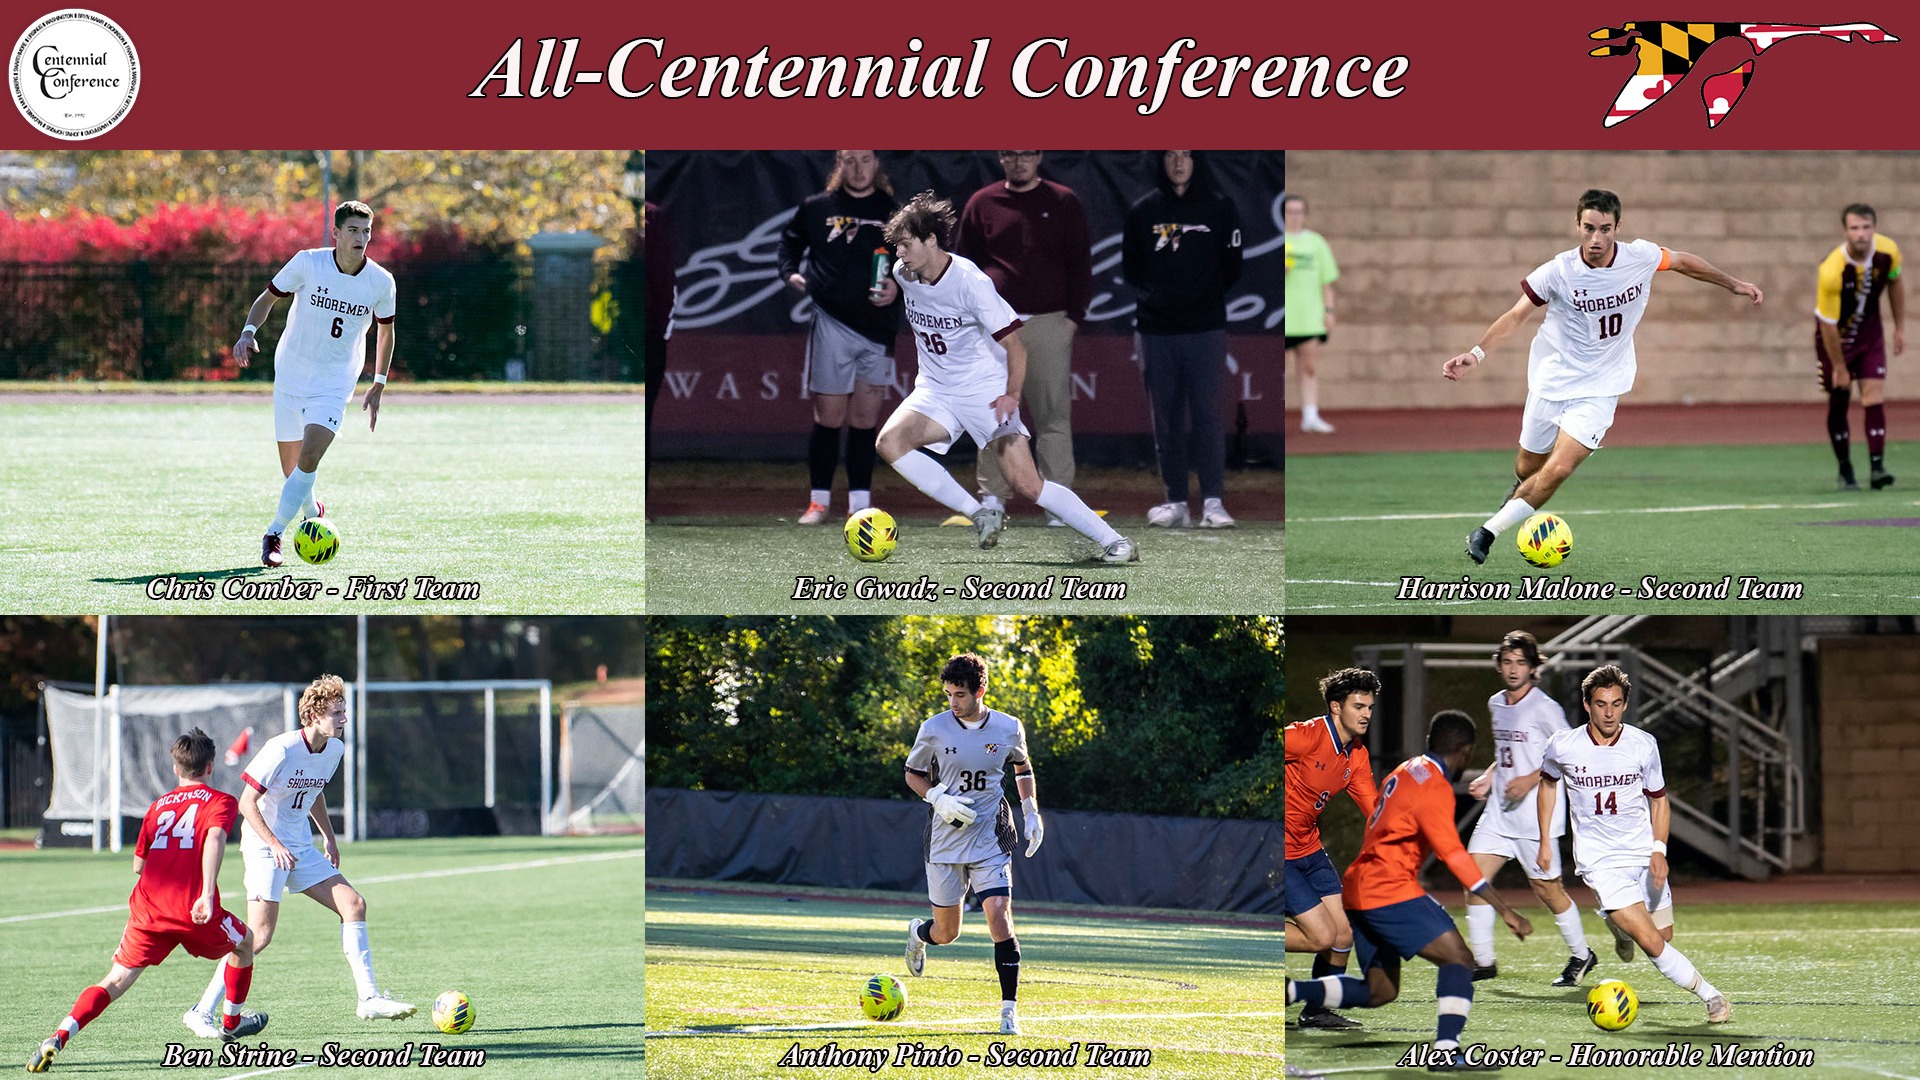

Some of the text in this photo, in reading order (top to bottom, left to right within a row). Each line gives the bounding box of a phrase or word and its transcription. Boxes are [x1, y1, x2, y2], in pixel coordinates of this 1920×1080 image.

[1573, 282, 1643, 313] SHOREMEN
[331, 316, 344, 339] 6
[906, 308, 963, 330] HOREMEN
[1598, 313, 1623, 340] 10
[919, 331, 948, 356] 26
[1500, 746, 1513, 768] 13
[287, 777, 329, 789] SHOREMEN
[959, 770, 987, 793] 36
[1571, 773, 1640, 788] SHOREMEN
[155, 789, 212, 811] DICKINSON
[291, 790, 308, 809] 11
[1594, 791, 1618, 816] 14
[149, 803, 197, 850] 24
